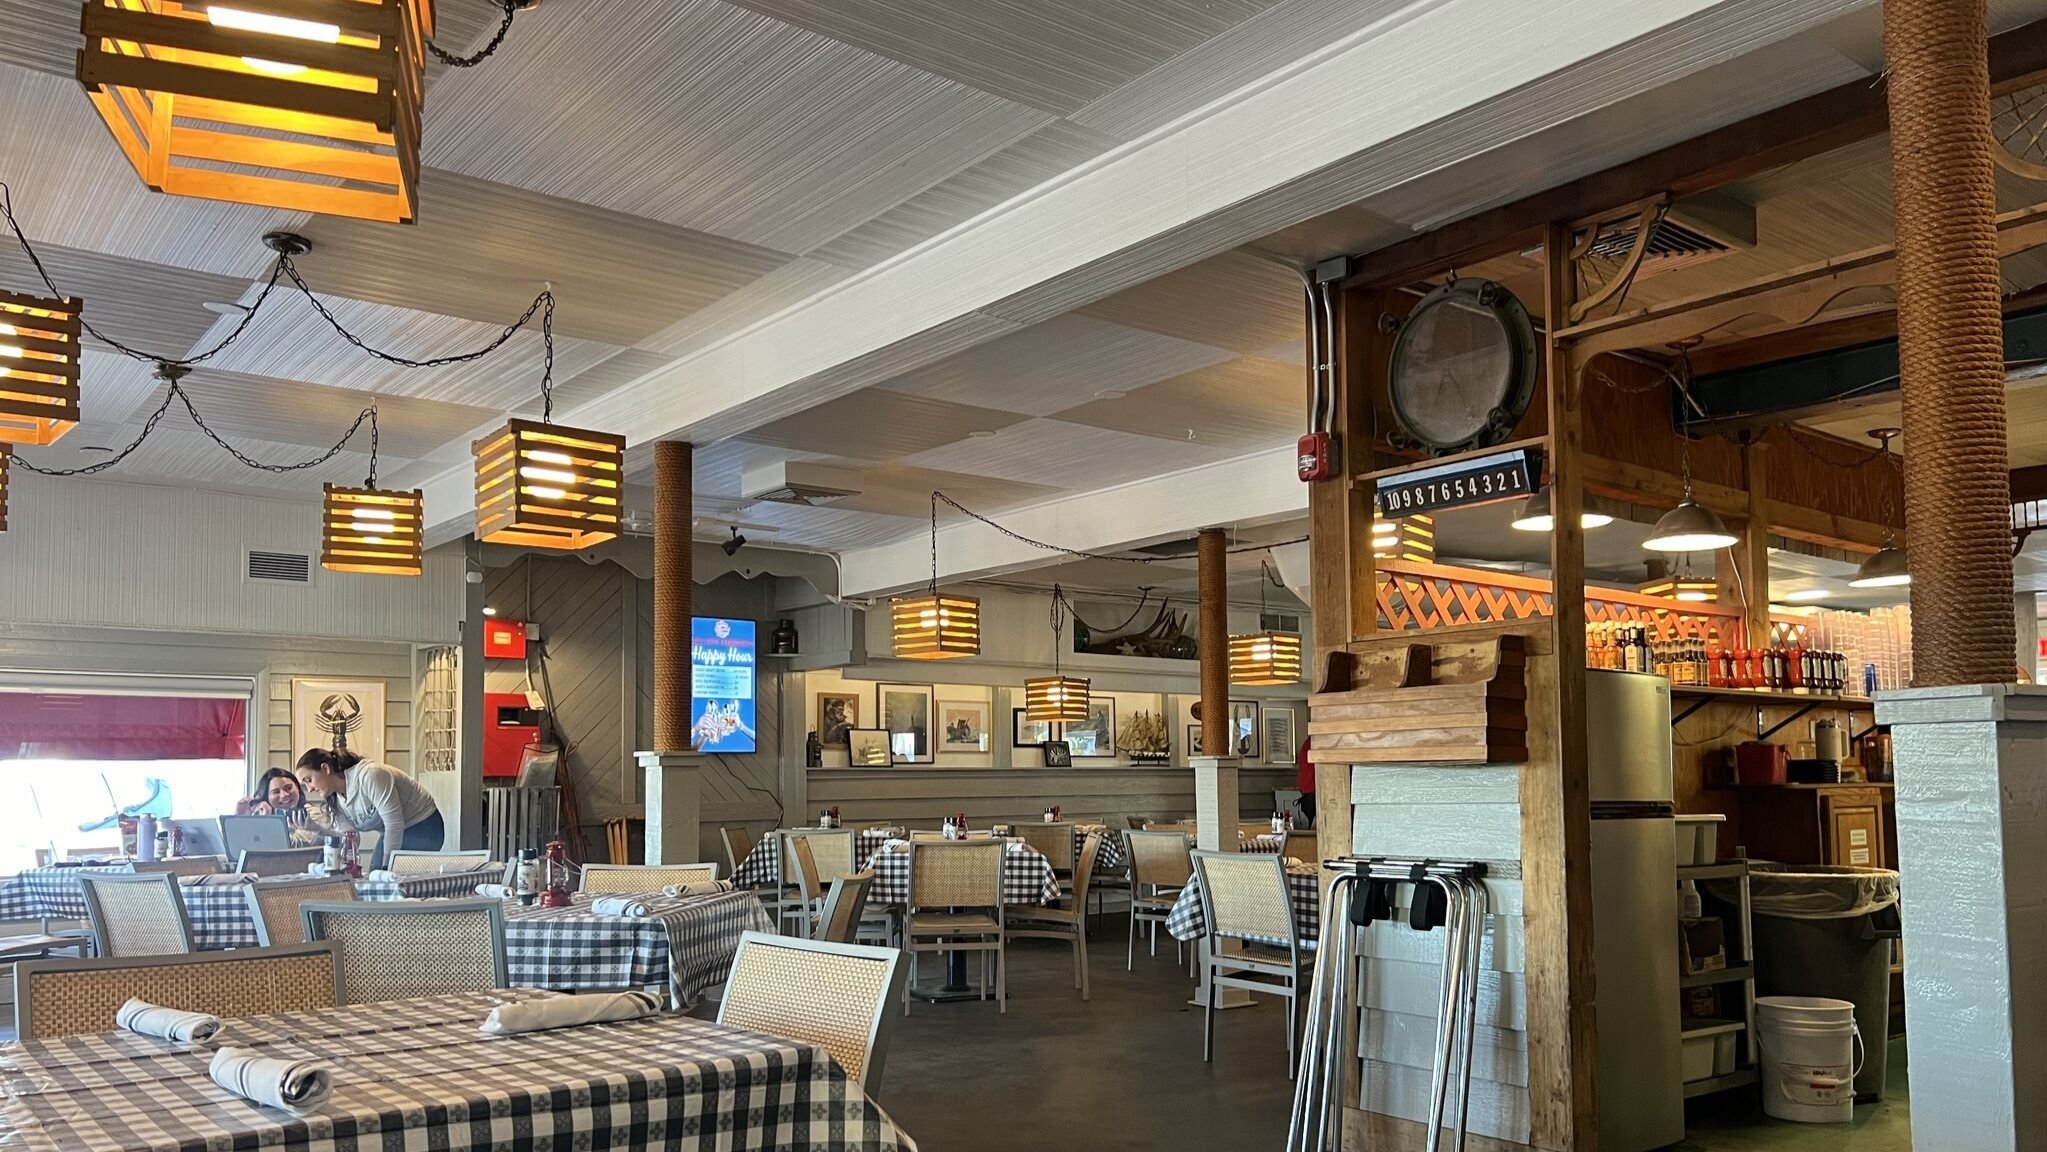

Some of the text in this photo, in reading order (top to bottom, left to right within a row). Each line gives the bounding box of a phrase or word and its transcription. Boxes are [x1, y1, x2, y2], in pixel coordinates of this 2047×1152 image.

[1387, 470, 1520, 510] 10 9 8 7 6 5 4 3 2 1
[691, 645, 753, 666] Happy Hour
